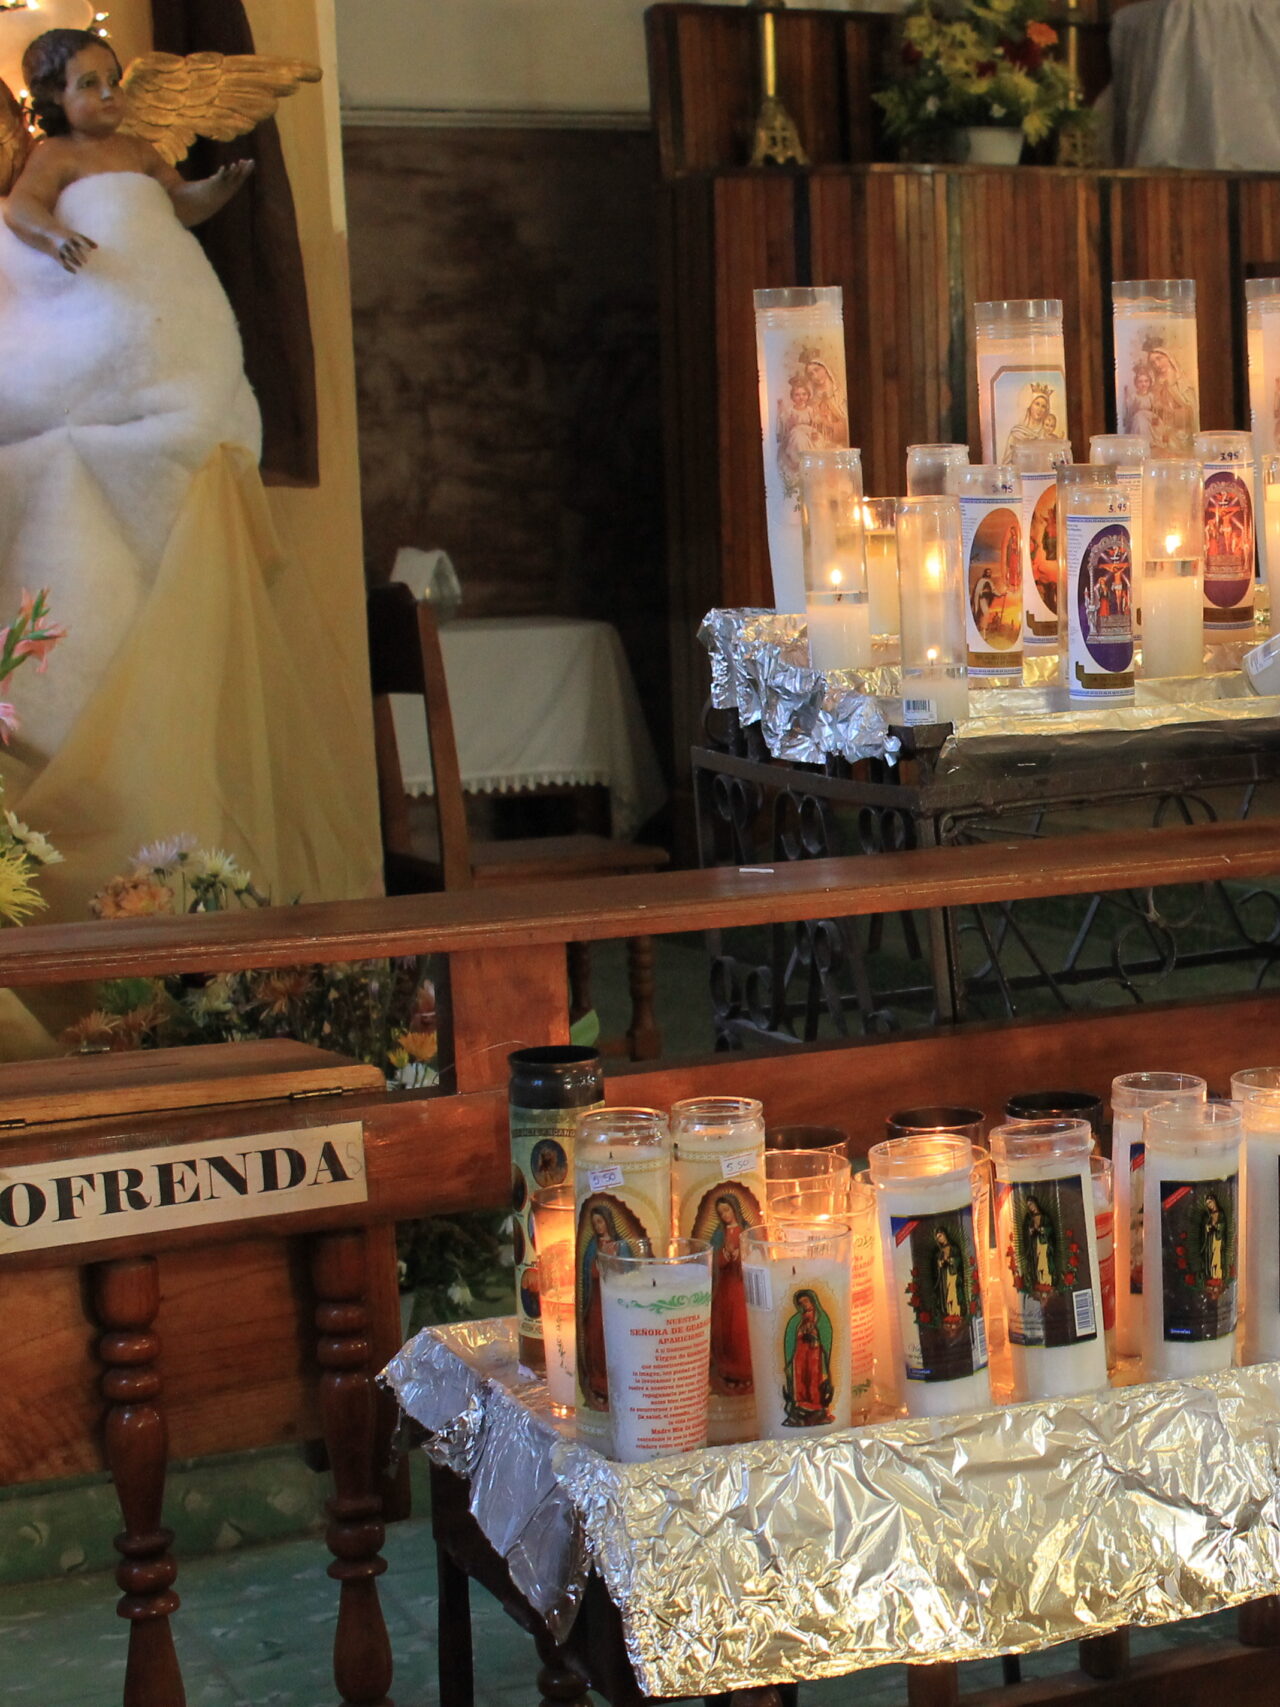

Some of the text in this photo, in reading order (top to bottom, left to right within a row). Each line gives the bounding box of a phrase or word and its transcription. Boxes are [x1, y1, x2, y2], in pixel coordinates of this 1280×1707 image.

[0, 1140, 354, 1228] OFRENDA
[629, 1328, 668, 1336] SEÑORA
[671, 1327, 684, 1335] DE
